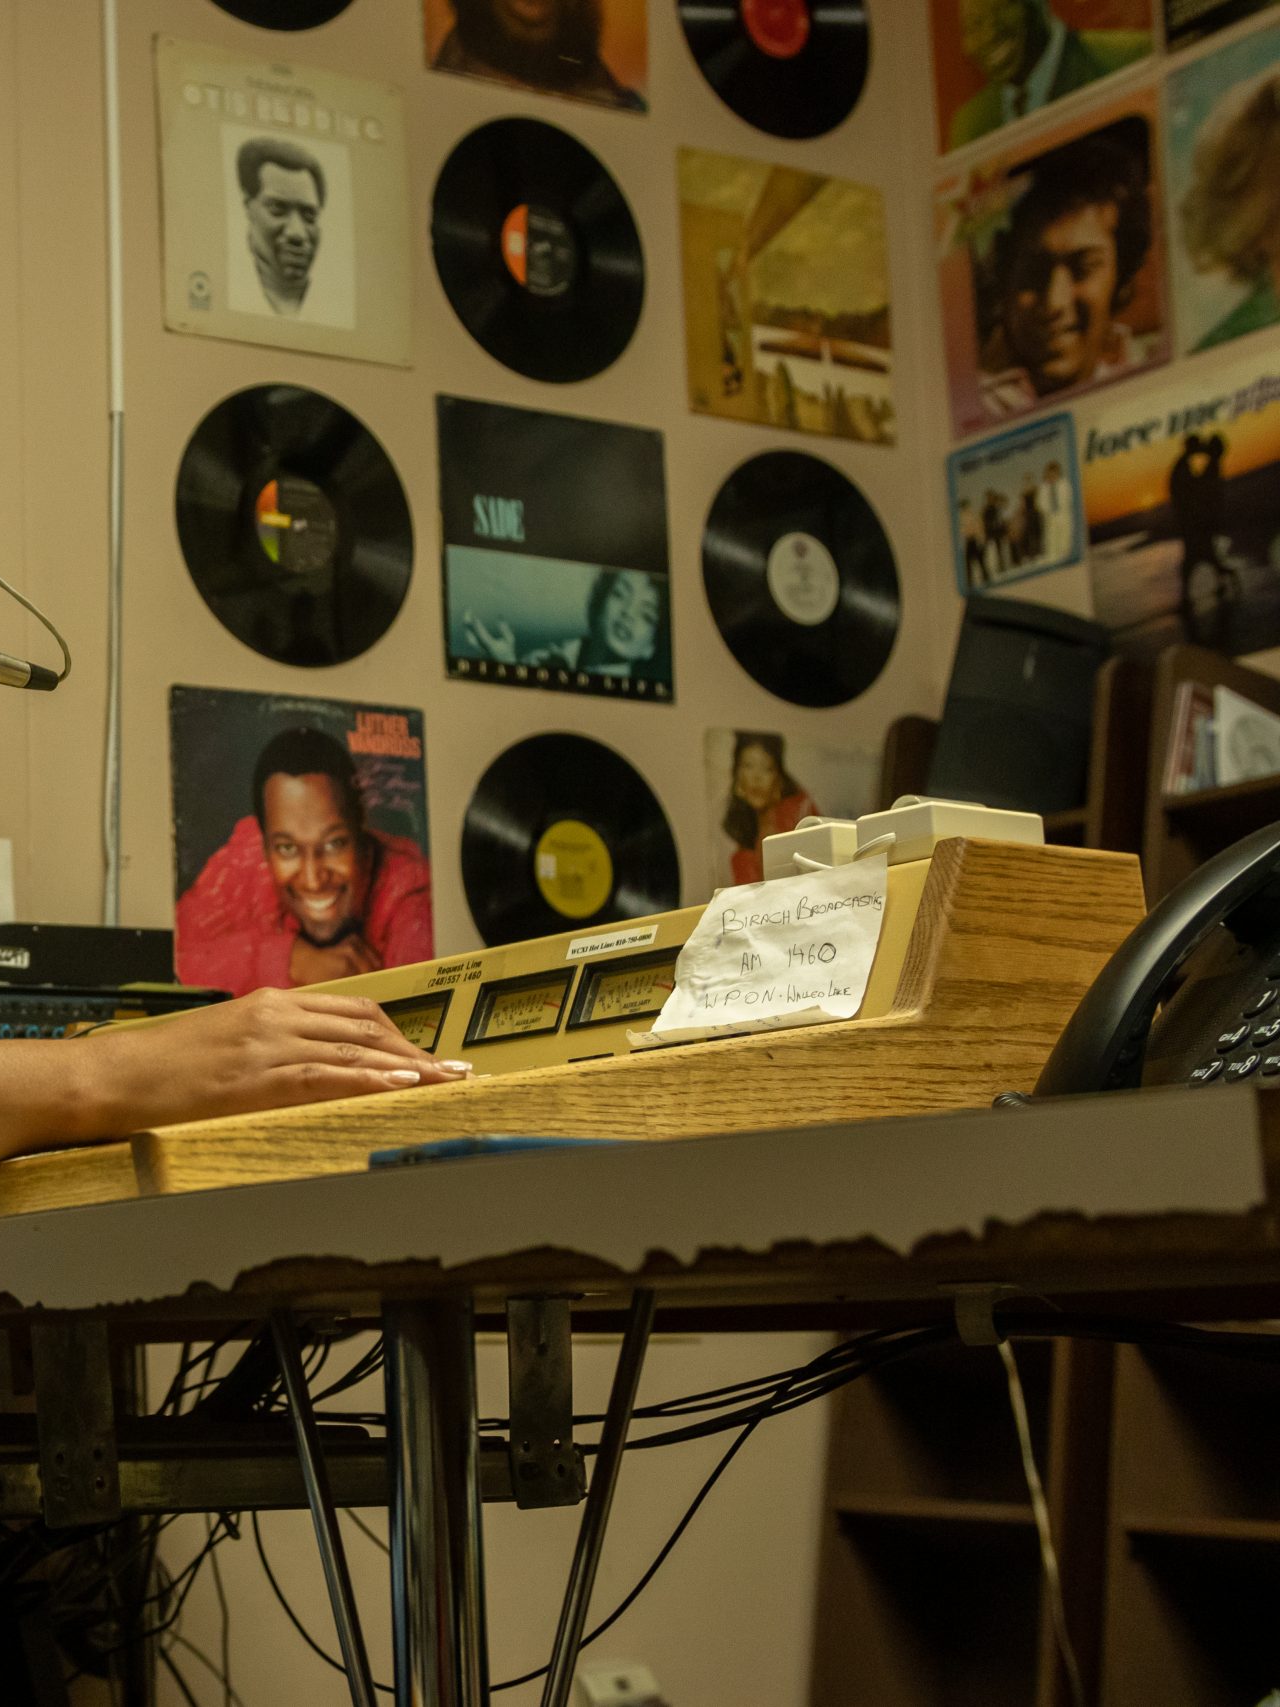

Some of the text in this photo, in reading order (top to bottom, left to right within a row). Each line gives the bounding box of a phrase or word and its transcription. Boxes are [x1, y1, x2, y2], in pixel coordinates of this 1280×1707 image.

[473, 494, 526, 542] SADE
[458, 658, 667, 697] DIAMOND LIFE
[355, 711, 409, 737] LUTHER
[571, 946, 589, 955] WCXI
[589, 944, 600, 952] Hot
[600, 941, 615, 949] Line:
[437, 959, 482, 976] Request Line
[740, 941, 837, 976] AM 1460
[463, 970, 482, 982] 1460
[827, 979, 852, 997] LAKE
[1256, 990, 1273, 1008] 1
[1230, 1025, 1247, 1043] 4
[1266, 1018, 1280, 1037] 5
[1202, 1061, 1221, 1080] 7
[1238, 1055, 1257, 1074] 8
